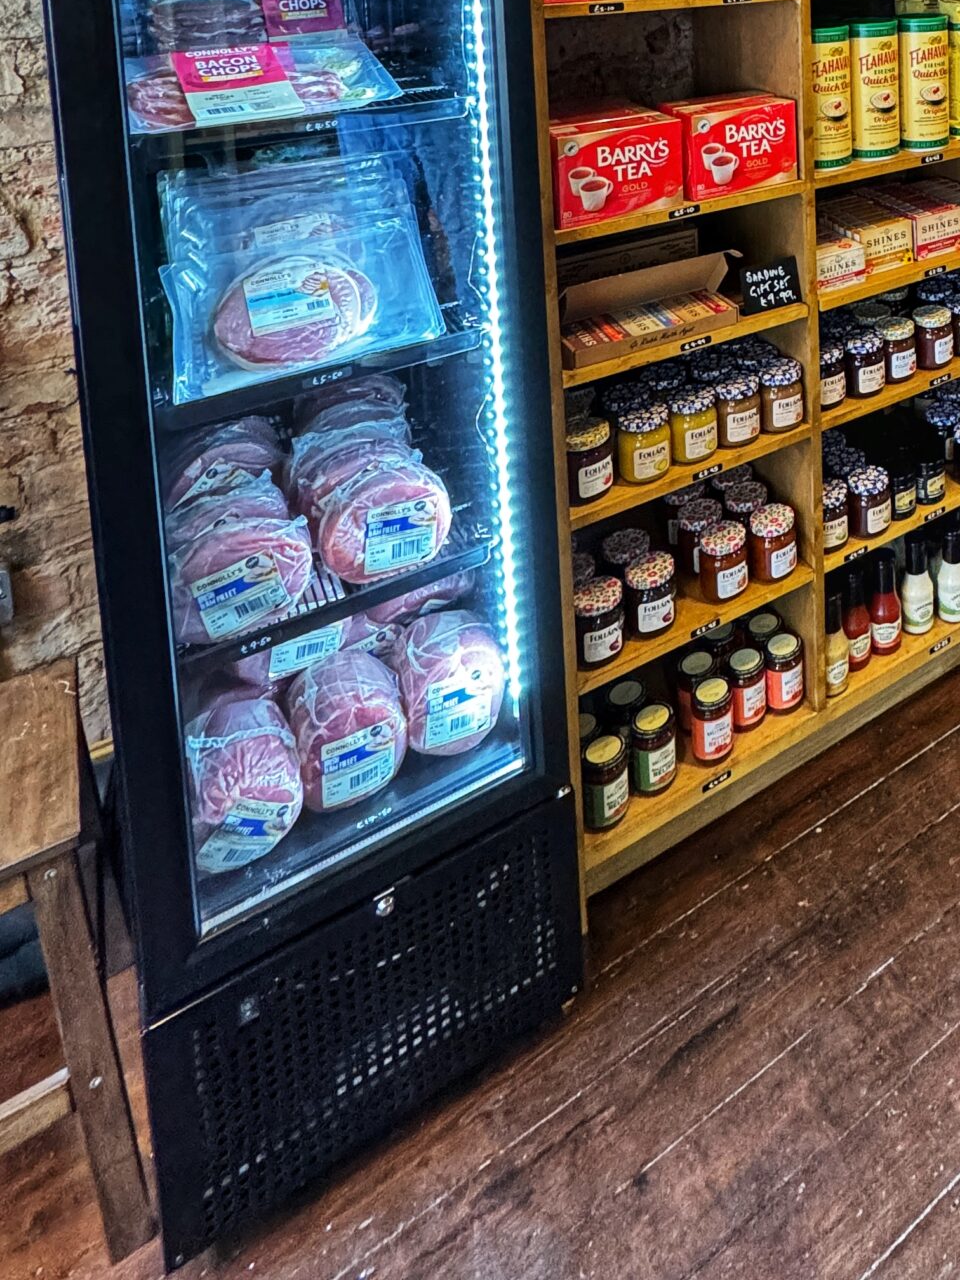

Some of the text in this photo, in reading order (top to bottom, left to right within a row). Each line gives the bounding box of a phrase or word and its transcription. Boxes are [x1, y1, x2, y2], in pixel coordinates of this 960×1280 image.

[185, 45, 260, 58] CONNOLLY'S
[195, 55, 258, 69] BACON
[198, 63, 262, 77] CHOPS
[863, 75, 889, 85] Quick
[912, 69, 938, 79] Quick
[812, 82, 840, 93] Quick
[725, 116, 786, 145] BARRY'S
[596, 136, 669, 168] BARRY'S
[739, 139, 771, 158] TEA
[746, 157, 768, 168] GOLD
[613, 162, 653, 182] TEA
[622, 181, 648, 192] GOLD
[921, 217, 959, 234] SHINES
[866, 230, 907, 249] SHINES
[746, 266, 785, 283] SARDINE
[820, 259, 857, 276] SHINES
[750, 276, 791, 297] GIFT SET
[196, 567, 244, 592] CONNOLLY'S
[236, 803, 275, 817] CONNOLLY'S
